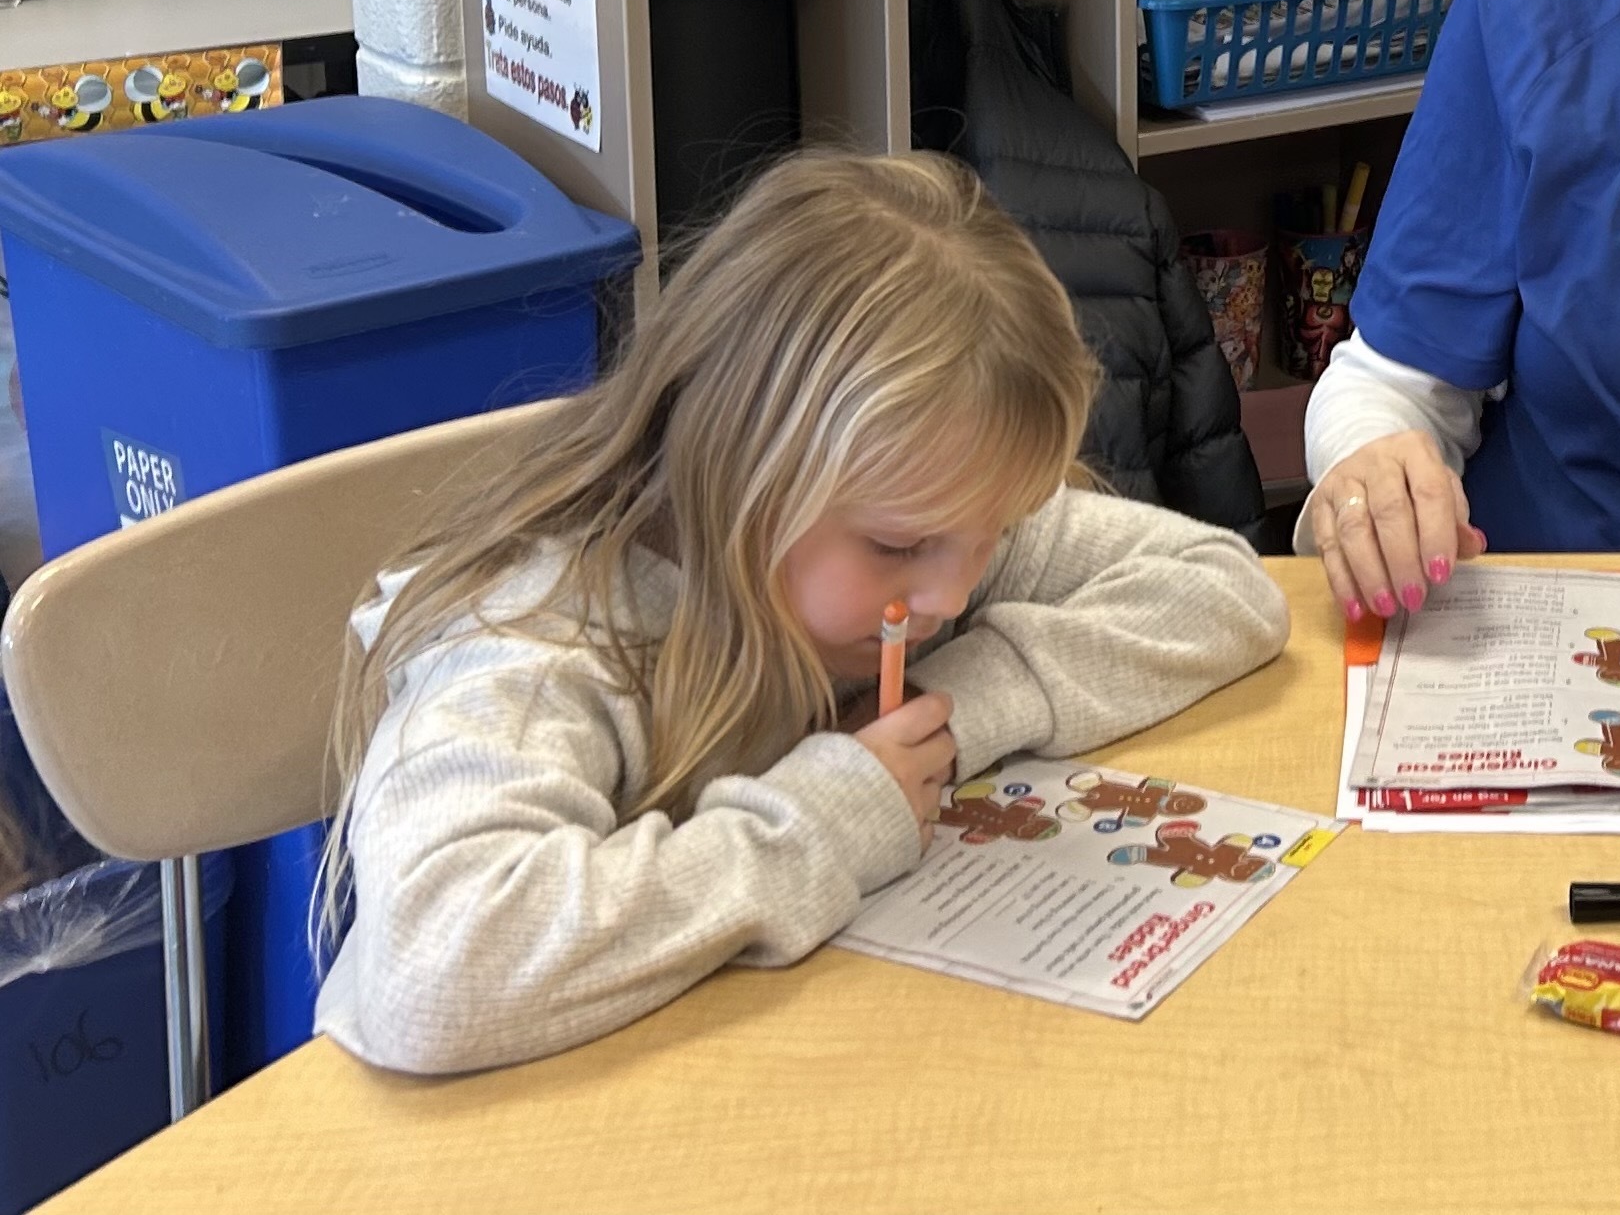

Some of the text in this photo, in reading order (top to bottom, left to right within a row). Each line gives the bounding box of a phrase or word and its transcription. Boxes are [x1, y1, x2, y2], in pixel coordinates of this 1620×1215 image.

[520, 28, 553, 59] ayuda.
[510, 58, 536, 94] estos
[538, 72, 569, 112] pasos.
[114, 440, 176, 496] PAPER
